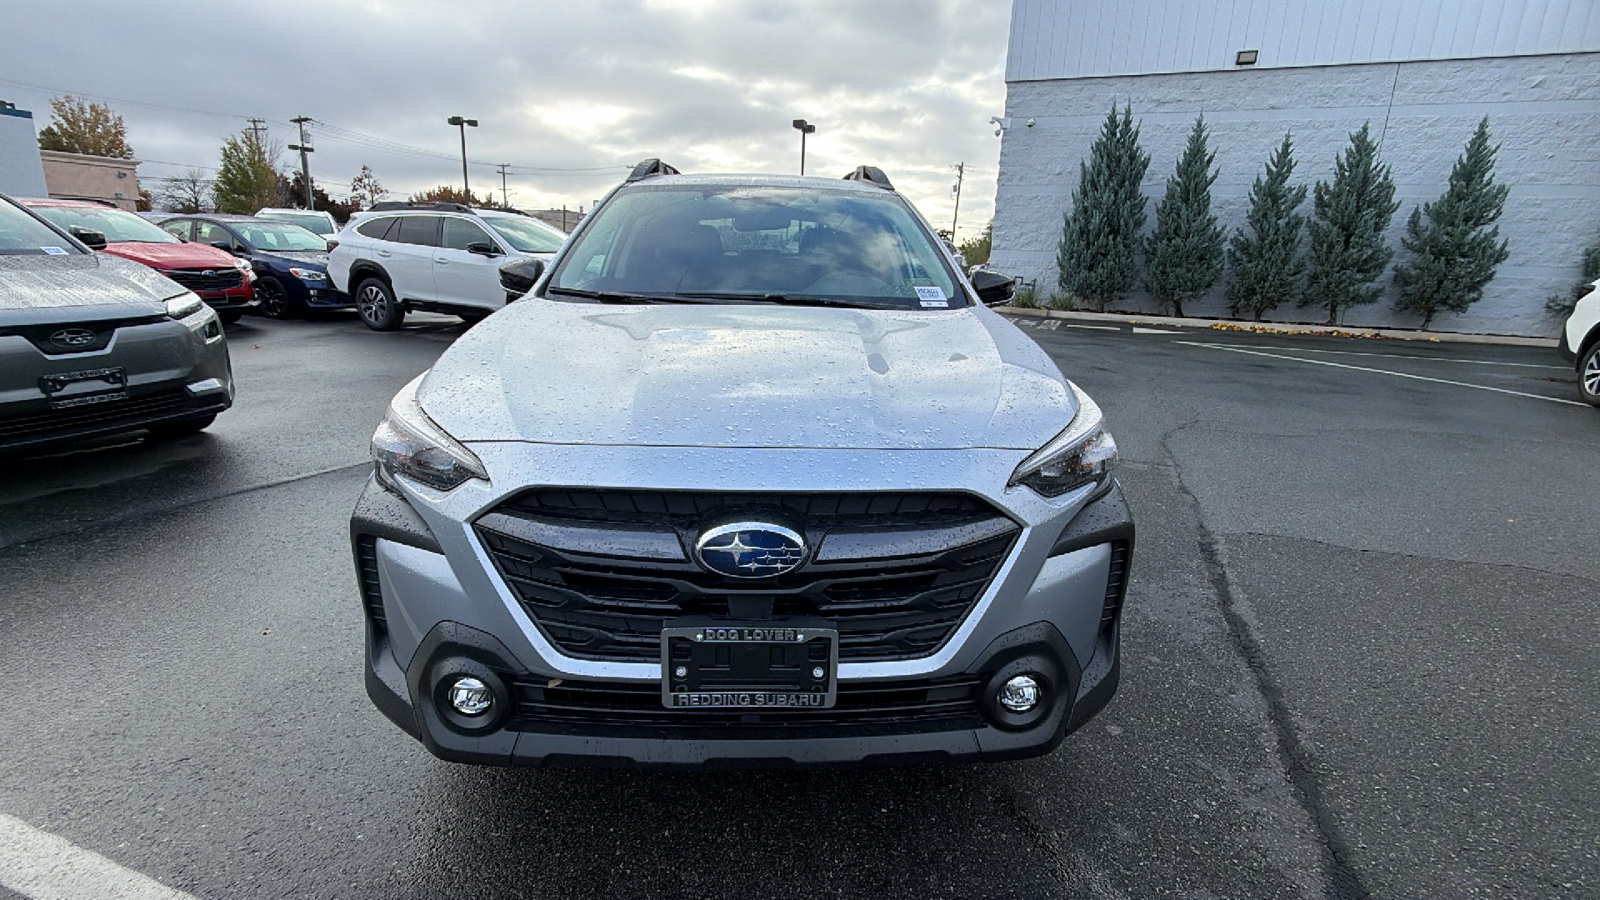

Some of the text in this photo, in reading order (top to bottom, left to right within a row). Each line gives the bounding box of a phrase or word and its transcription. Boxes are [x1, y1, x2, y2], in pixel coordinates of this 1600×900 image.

[705, 629, 795, 641] DOG LOVER
[678, 693, 821, 706] REDDING SUBARU
